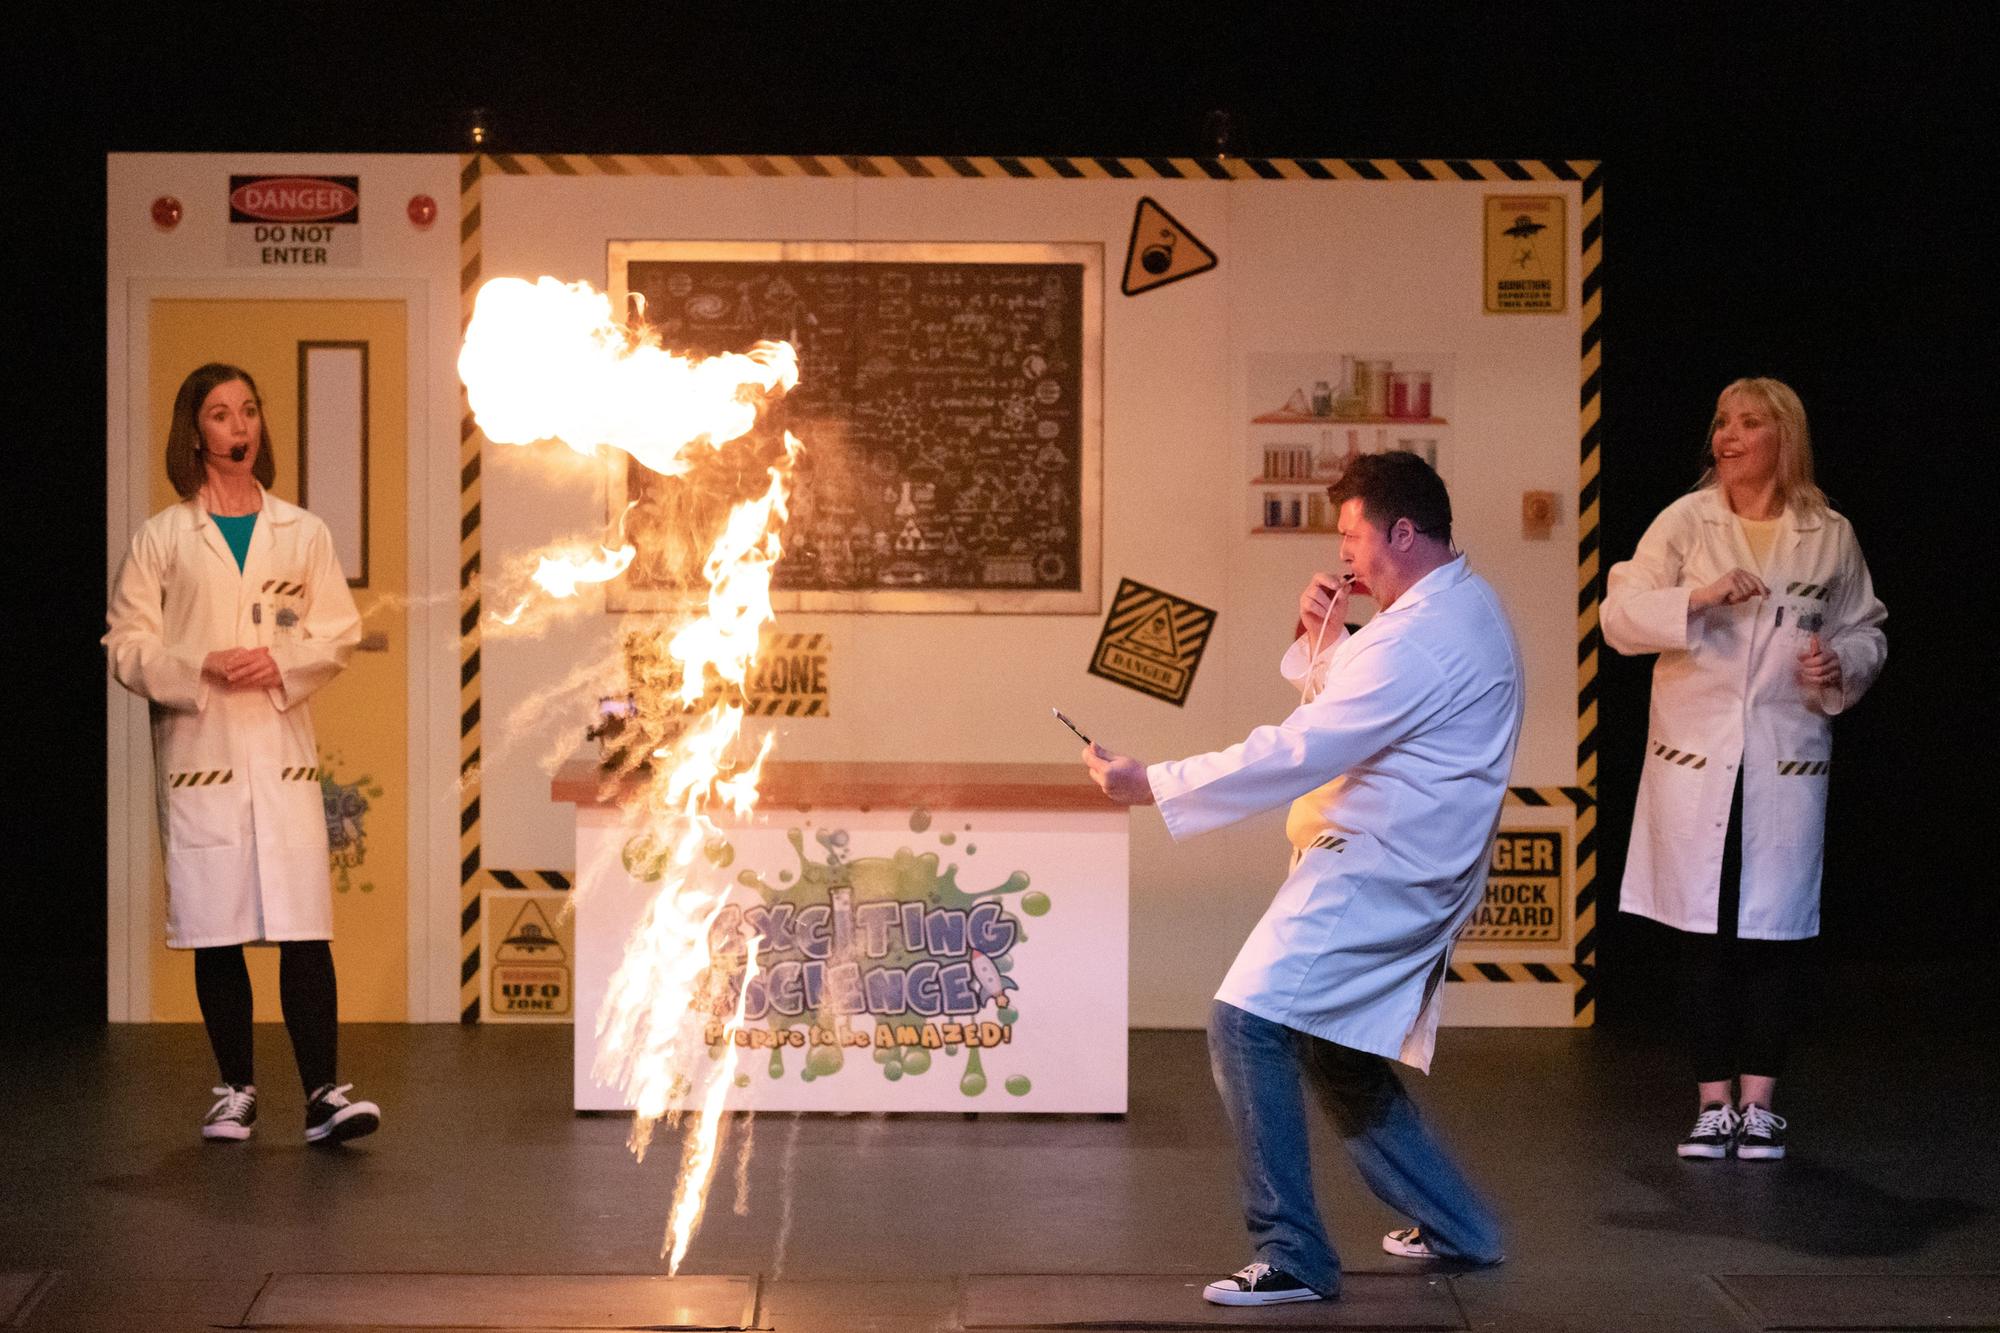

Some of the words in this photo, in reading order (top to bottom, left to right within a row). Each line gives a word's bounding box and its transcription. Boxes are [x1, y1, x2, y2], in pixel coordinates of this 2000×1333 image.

[245, 188, 344, 211] DANGER
[255, 226, 285, 243] DO
[292, 226, 334, 243] NOT
[262, 247, 327, 265] ENTER
[1113, 653, 1173, 683] DANGER
[1492, 838, 1554, 871] GER
[1485, 885, 1548, 904] HOCK
[502, 983, 561, 998] UFO
[728, 960, 981, 1020] SCIENCE
[507, 1000, 555, 1010] ZONE
[808, 1023, 835, 1047] to
[839, 1023, 871, 1048] be
[874, 1022, 1012, 1049] AMAZED!
